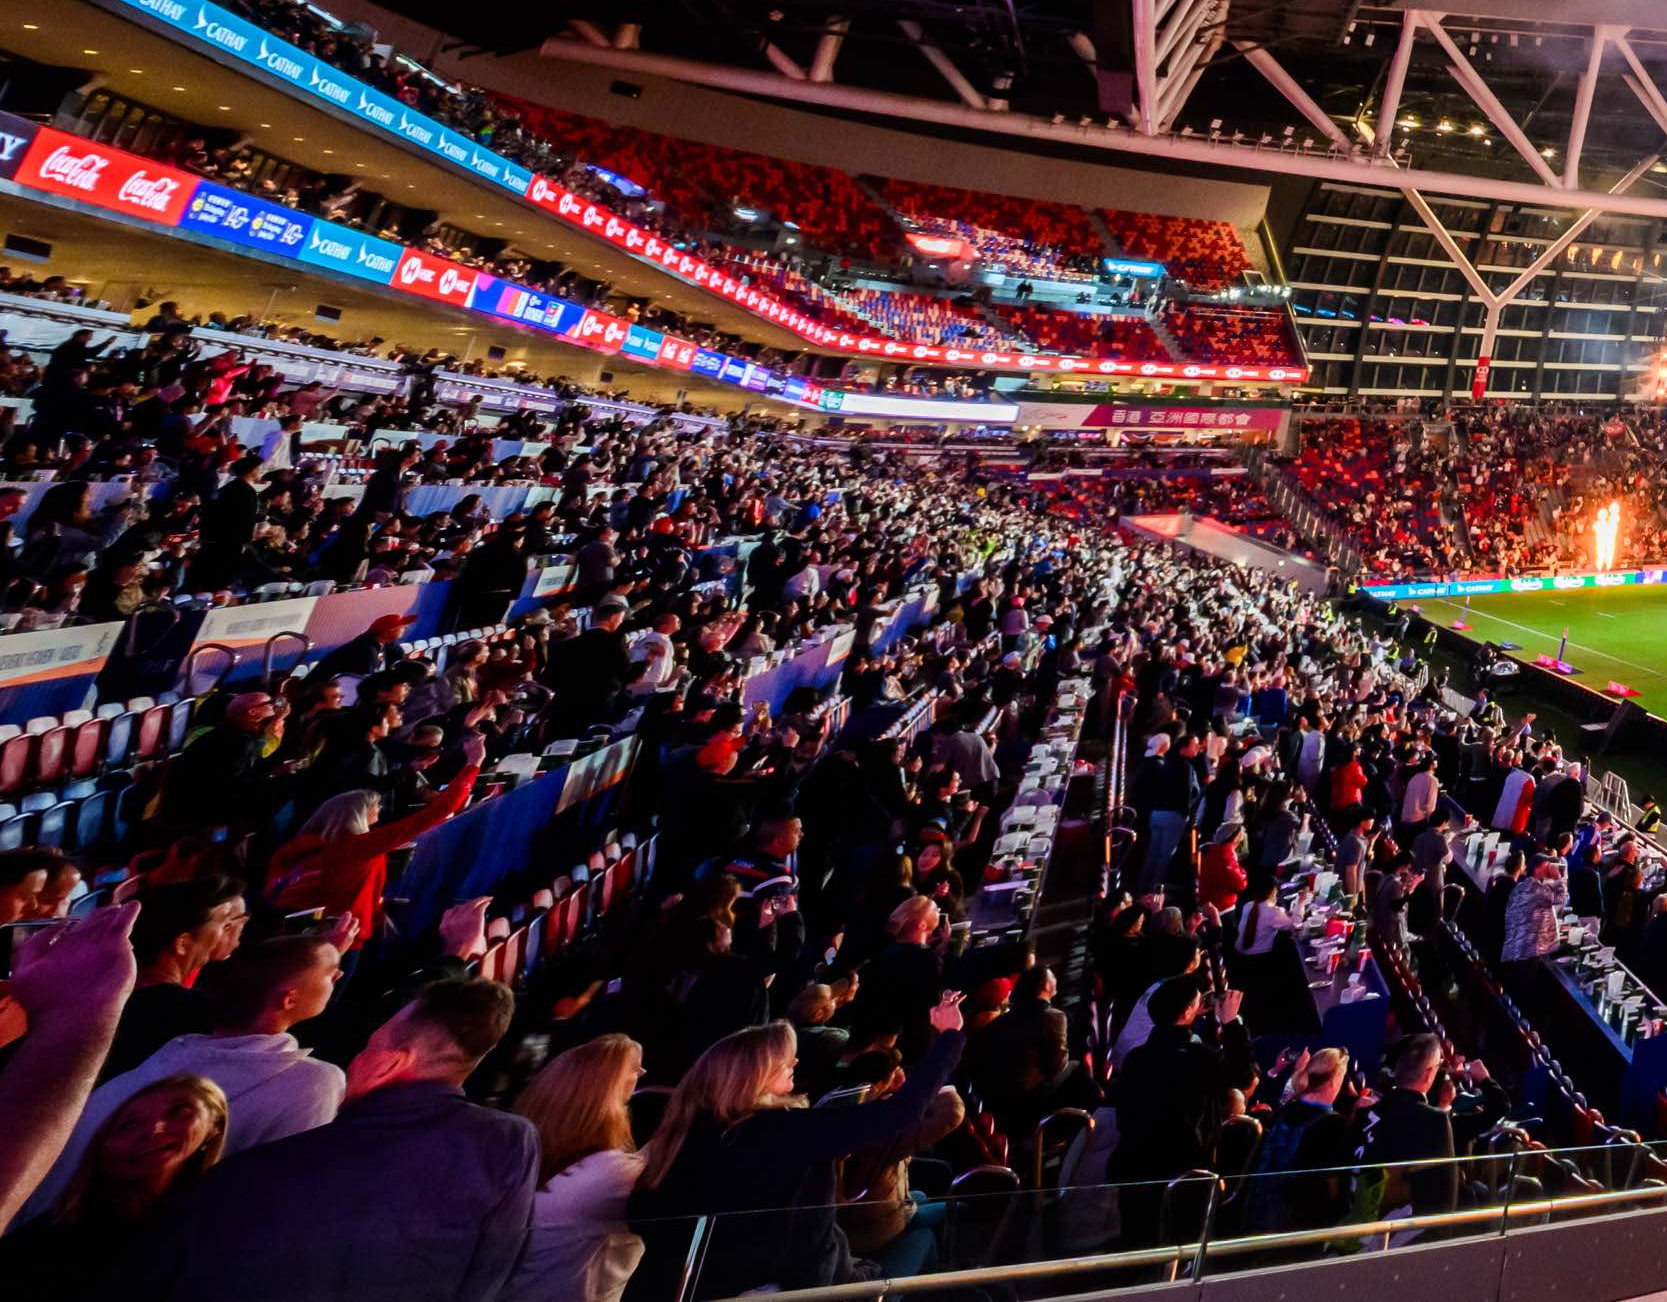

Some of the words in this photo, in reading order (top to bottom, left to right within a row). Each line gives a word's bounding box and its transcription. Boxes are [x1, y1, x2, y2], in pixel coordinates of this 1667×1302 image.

[206, 22, 248, 52] CATHAY
[267, 52, 304, 80] CATHAY
[318, 78, 351, 104] CATHAY
[366, 102, 396, 126] CATHAY
[319, 239, 352, 261] CATHAY
[365, 253, 396, 273] CATHAY
[1111, 409, 1141, 424] 香港
